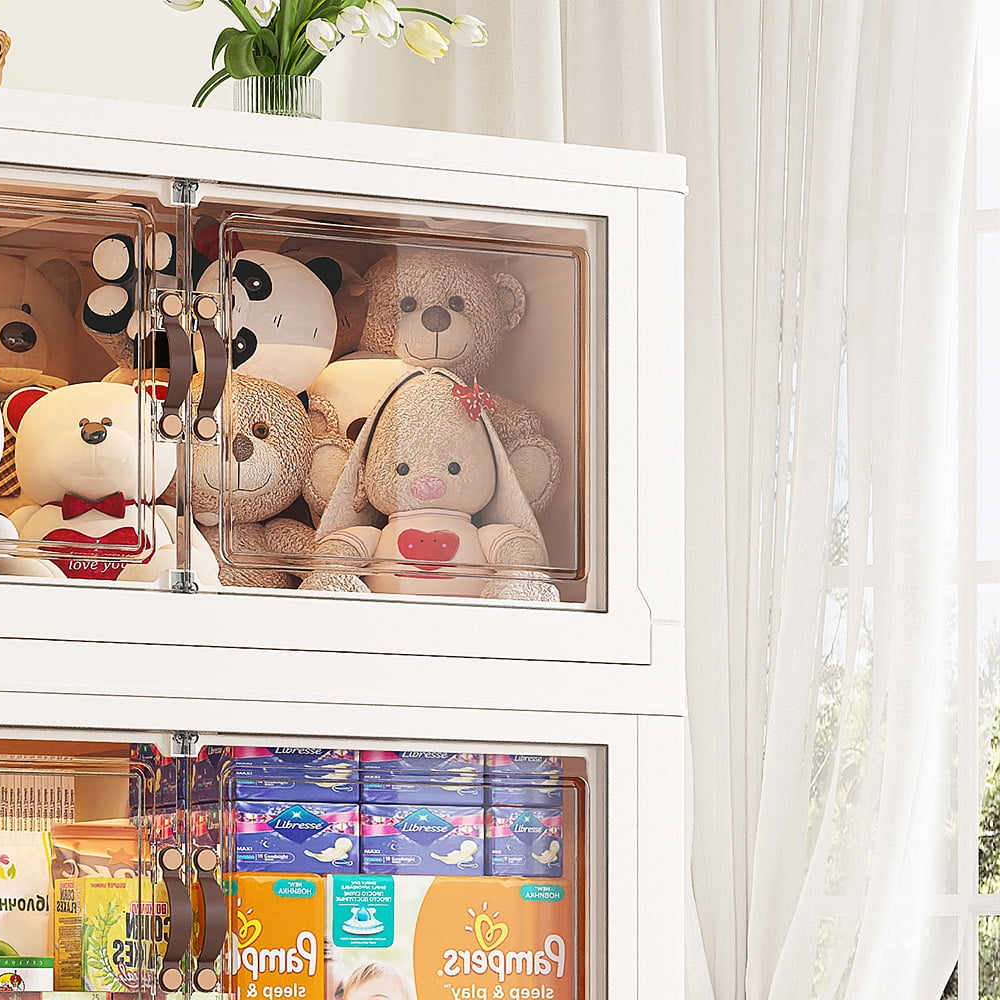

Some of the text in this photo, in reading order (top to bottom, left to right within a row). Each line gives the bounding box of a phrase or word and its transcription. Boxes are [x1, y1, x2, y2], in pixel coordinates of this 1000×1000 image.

[68, 560, 98, 570] love
[275, 747, 323, 755] Libresse
[275, 819, 324, 829] Libresse
[402, 822, 449, 832] Libresse
[514, 824, 543, 833] Libresse
